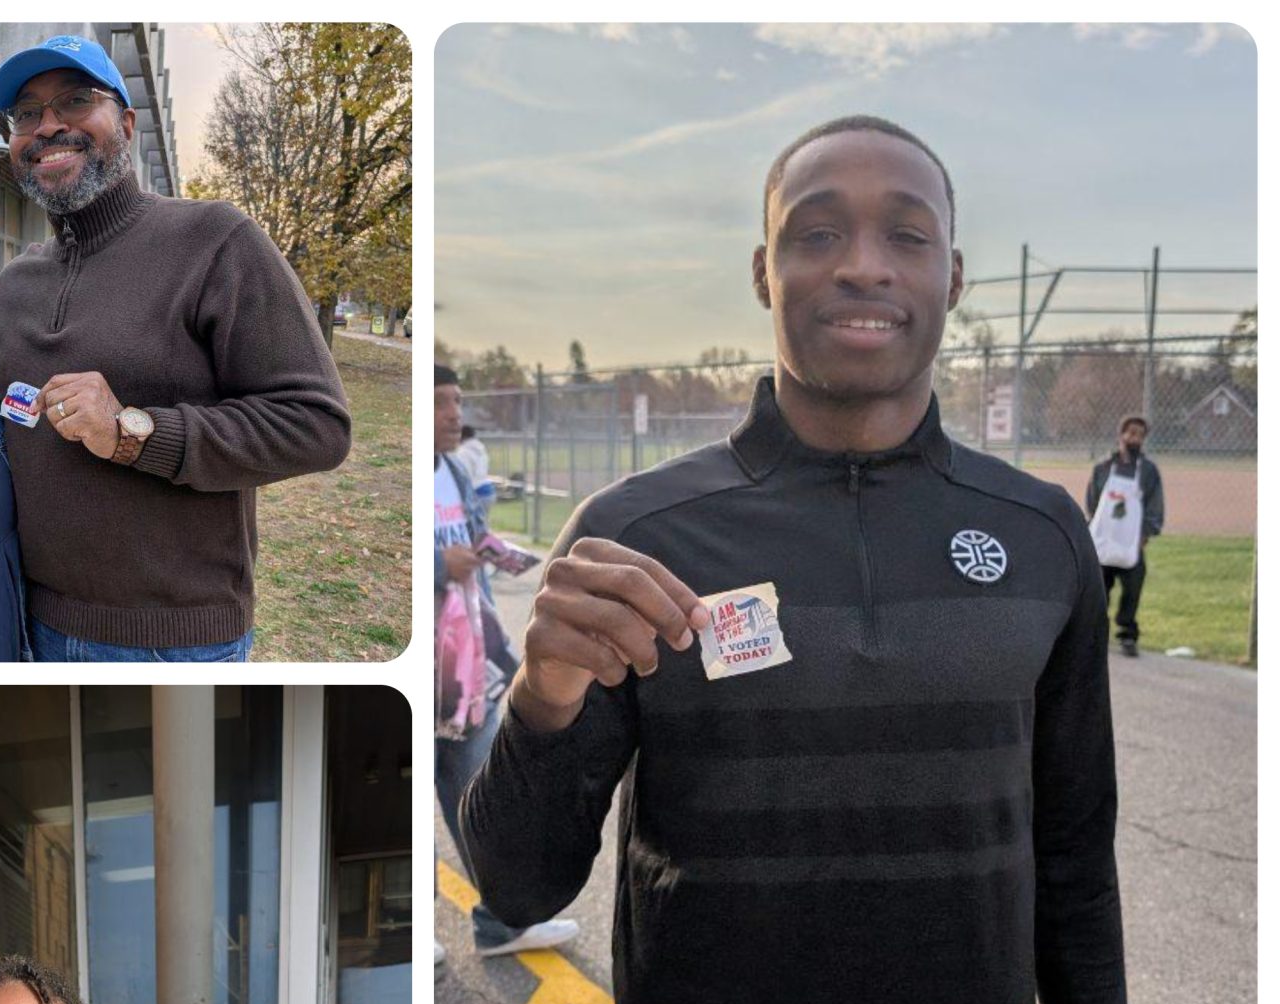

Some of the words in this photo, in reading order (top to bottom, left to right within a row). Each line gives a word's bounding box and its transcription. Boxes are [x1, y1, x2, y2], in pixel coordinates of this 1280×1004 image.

[718, 602, 737, 622] AM
[728, 637, 770, 652] VOTED
[723, 647, 772, 664] TODAY!
